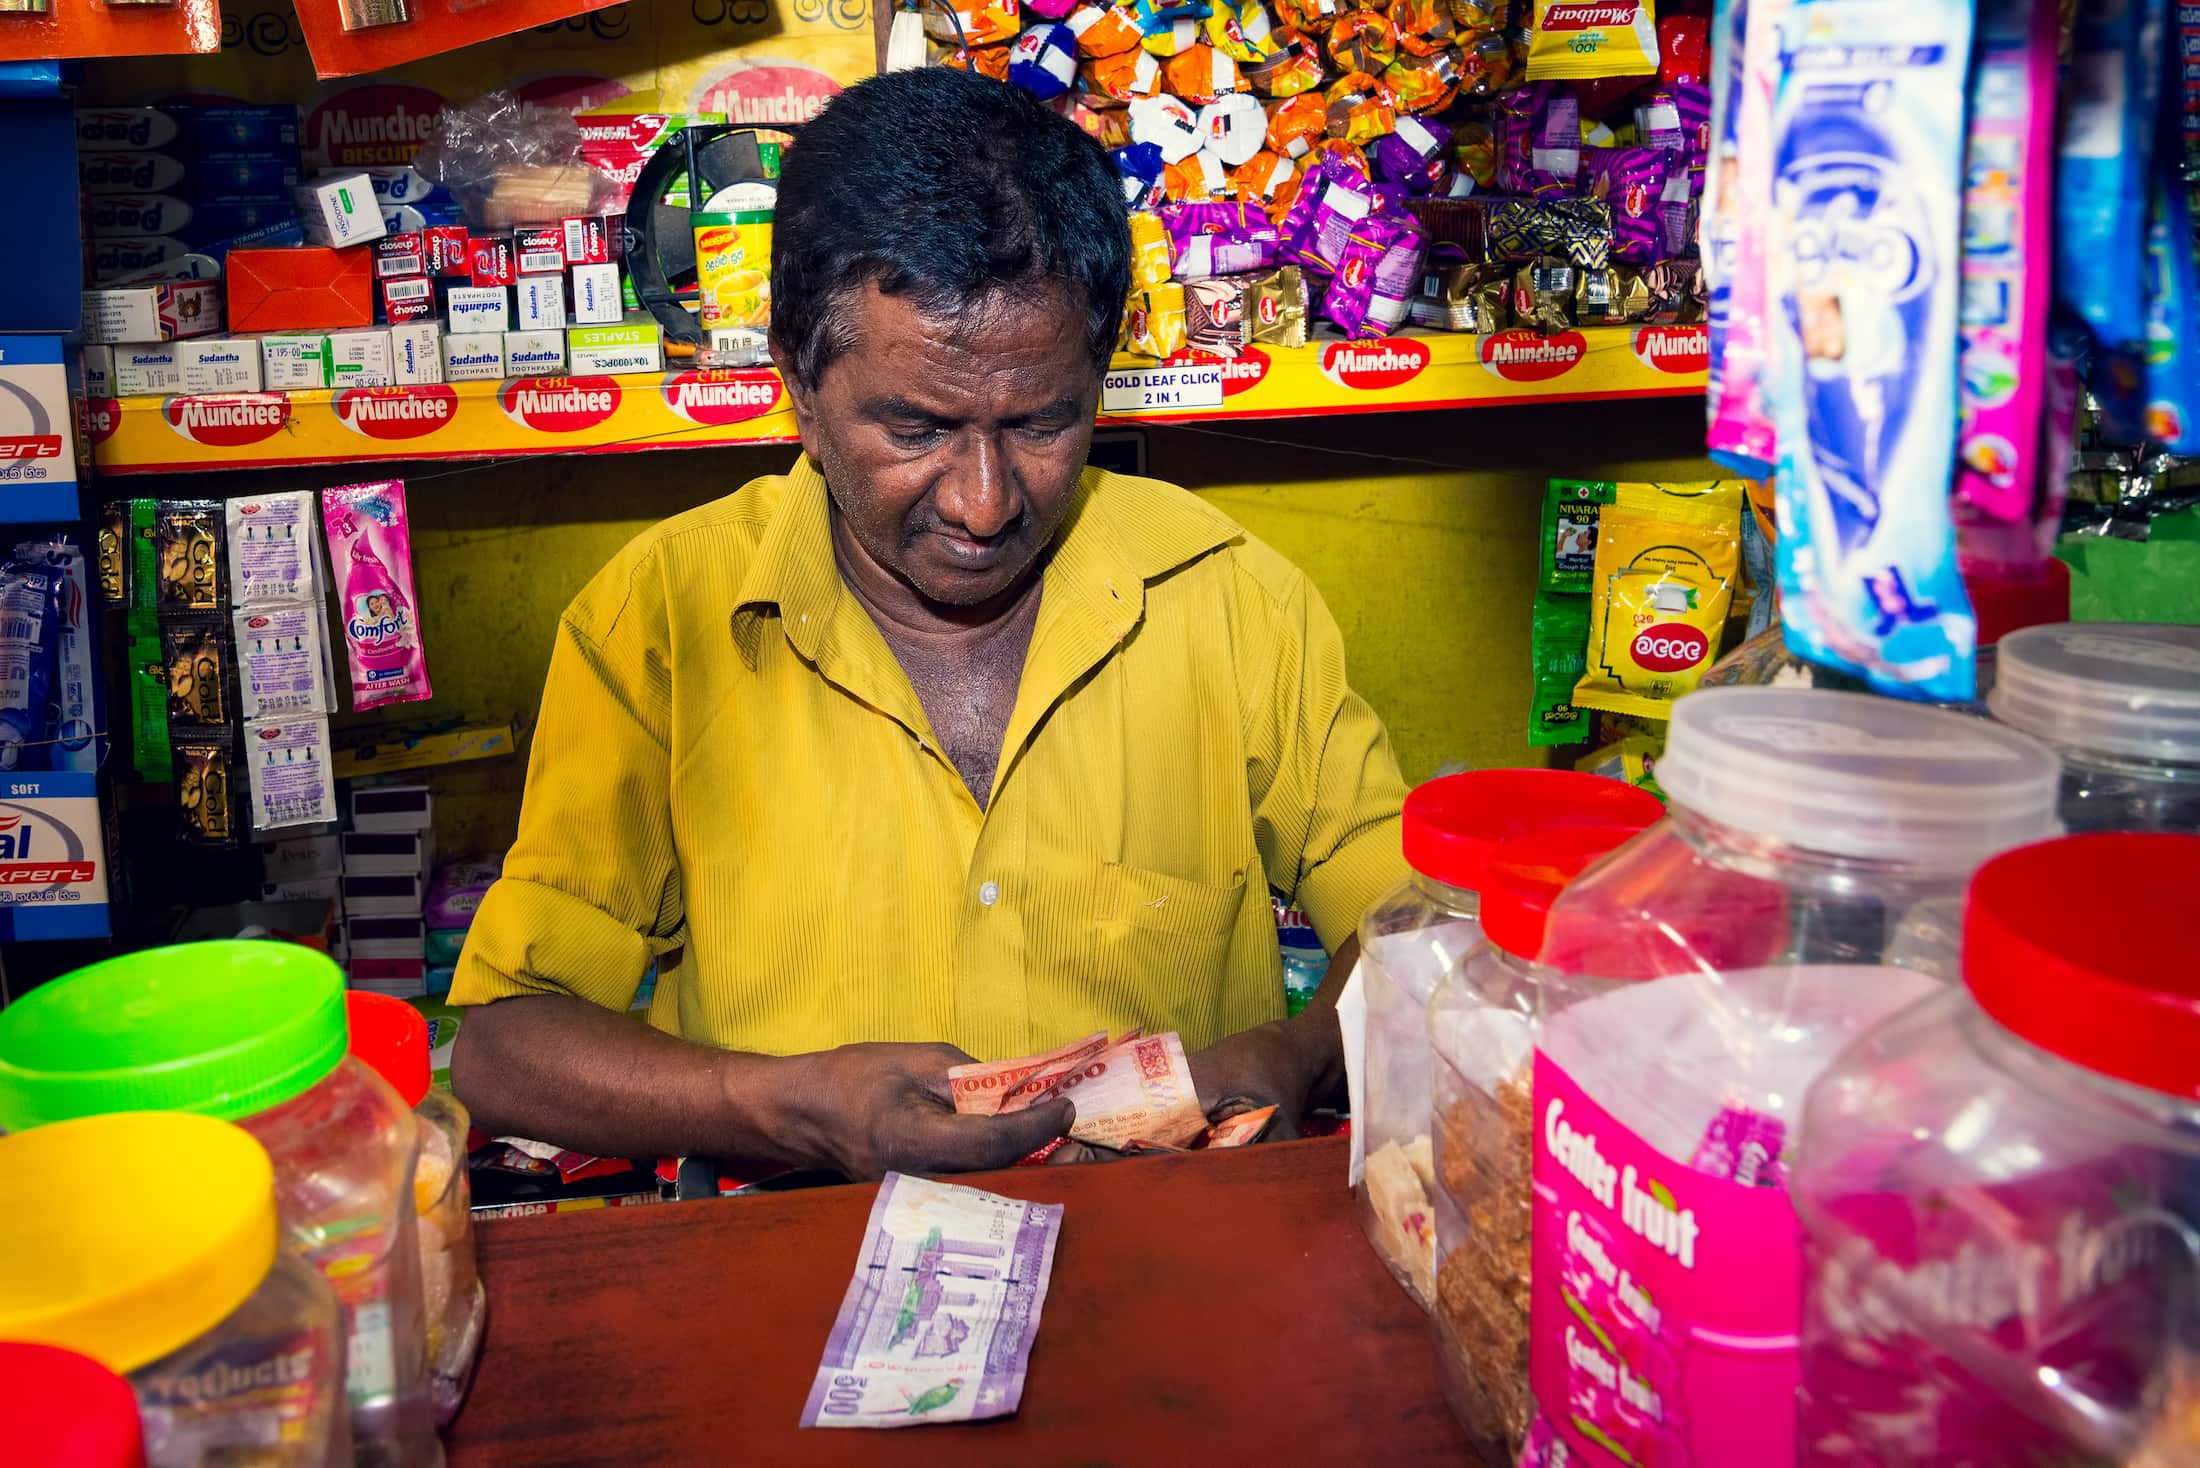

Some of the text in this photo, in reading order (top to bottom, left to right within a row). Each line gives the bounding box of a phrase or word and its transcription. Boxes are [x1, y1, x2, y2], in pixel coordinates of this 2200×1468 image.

[1553, 7, 1646, 25] Maliban
[378, 238, 414, 252] closeup
[522, 236, 558, 248] closeup
[590, 222, 599, 256] closeup
[431, 235, 442, 271] closeup
[498, 244, 507, 279] closeup
[452, 291, 502, 300] TOOTHPASTE
[451, 301, 502, 313] Sudantha
[530, 285, 538, 321] Sudantha
[393, 304, 429, 317] closeup
[584, 331, 640, 343] STAPLES
[131, 354, 173, 366] Sudantha
[198, 352, 240, 365] Sudantha
[449, 353, 500, 367] Sudantha
[511, 351, 561, 363] Sudantha
[1492, 340, 1579, 366] Munchee
[1332, 348, 1421, 373] Munchee
[450, 367, 499, 376] TOOTHPASTE
[1104, 372, 1220, 389] GOLD LEAF CLICK
[514, 388, 612, 415] Munchee
[678, 381, 774, 408] Munchee
[1144, 391, 1182, 404] 2 IN 1
[350, 393, 448, 422] Munchee
[181, 403, 281, 429] Munchee
[1559, 503, 1601, 515] NIVARA
[1576, 515, 1589, 524] 90
[342, 521, 352, 535] 3
[349, 610, 408, 645] Comfort
[1635, 635, 1701, 661] වටවල
[365, 677, 411, 690] AFTER WASH
[1557, 704, 1569, 713] 90
[10, 784, 41, 795] SOFT
[205, 770, 222, 833] Gold
[1544, 1097, 1618, 1210] Center
[1621, 1164, 1700, 1270] fruit
[823, 1374, 869, 1415] 500
